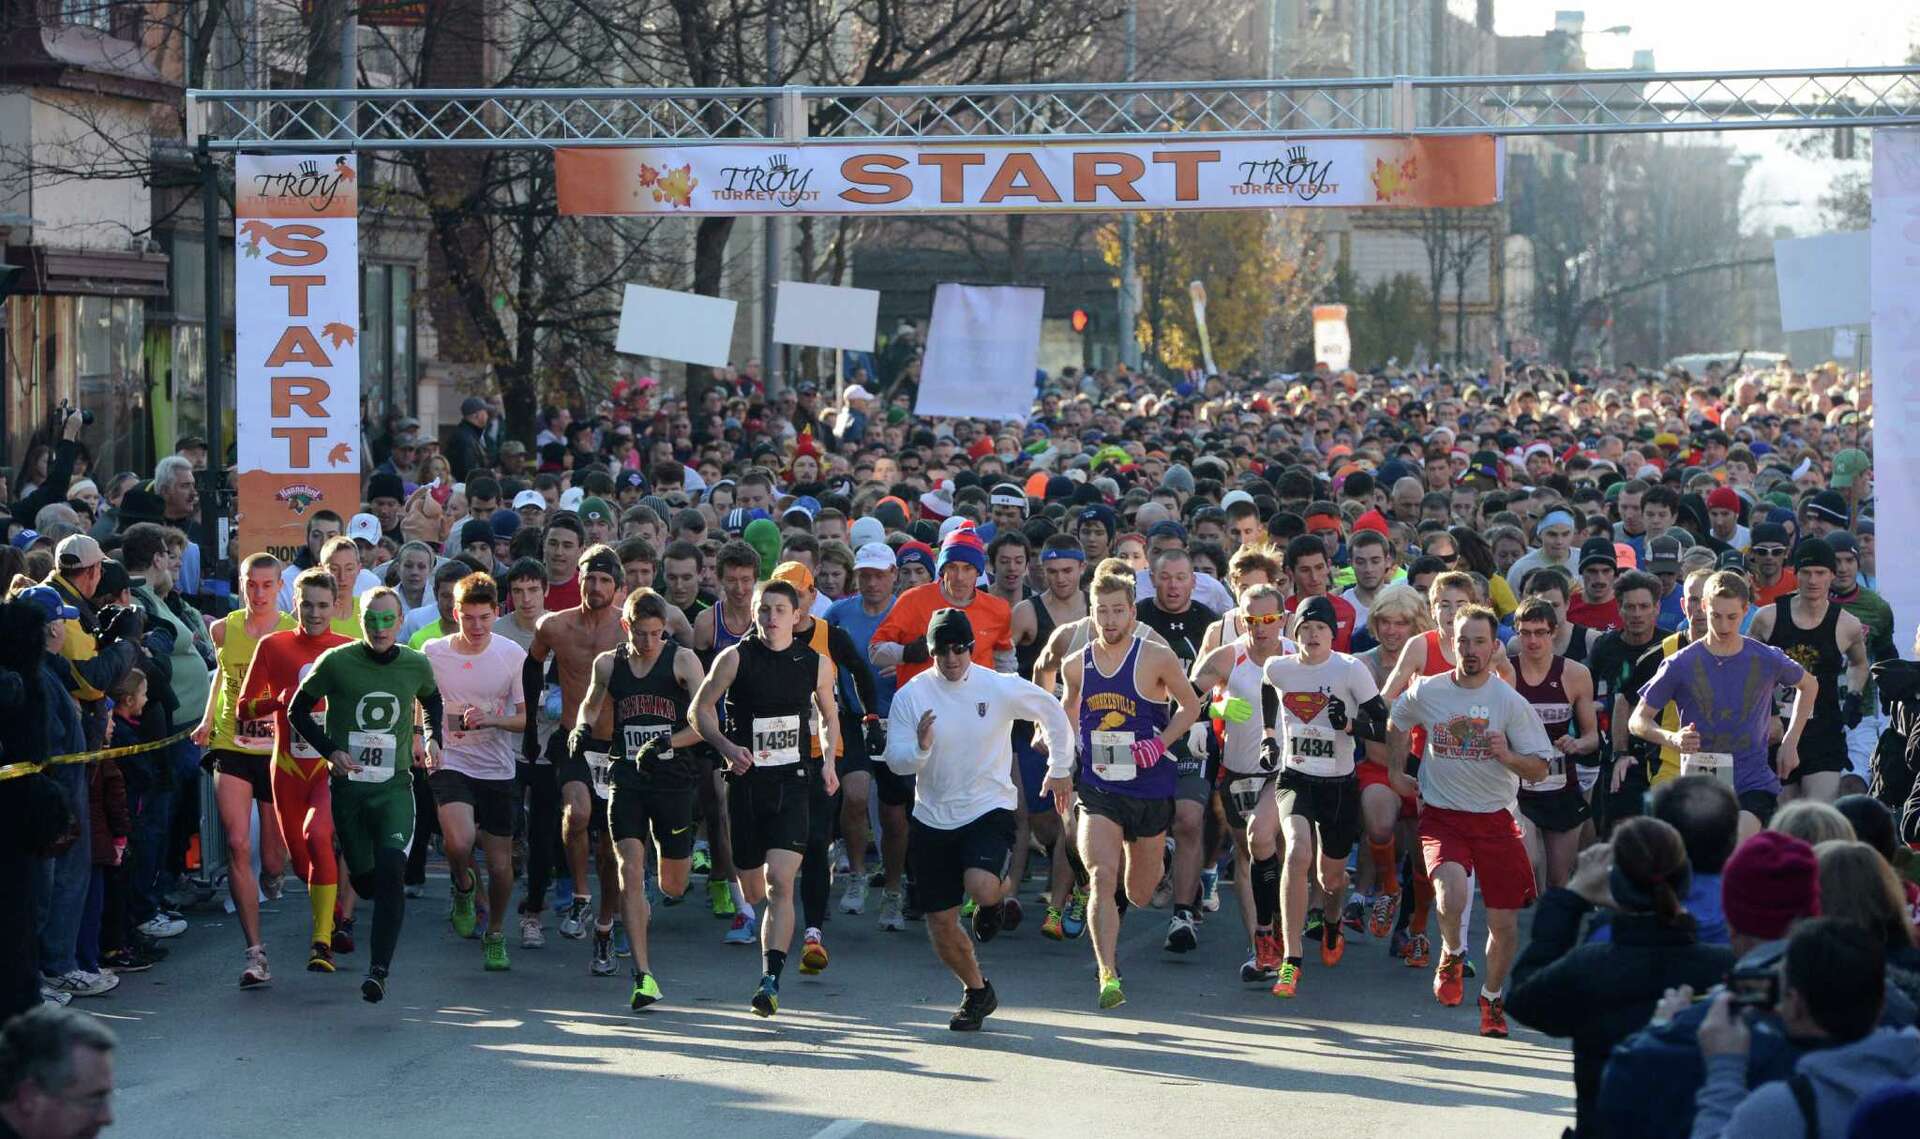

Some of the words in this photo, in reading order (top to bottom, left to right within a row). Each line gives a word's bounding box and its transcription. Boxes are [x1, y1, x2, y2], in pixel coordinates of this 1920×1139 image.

[720, 165, 814, 207] TROY
[837, 150, 1221, 205] START
[1238, 158, 1333, 201] TROY
[254, 171, 343, 212] TROY
[712, 190, 776, 201] TURKEY
[780, 190, 820, 201] TROT
[1229, 184, 1294, 196] TURKEY
[1297, 183, 1340, 194] TROT
[264, 224, 334, 469] START
[755, 729, 798, 751] 1435
[1290, 737, 1334, 758] 1434
[359, 747, 382, 766] 48
[1106, 746, 1114, 764] 1
